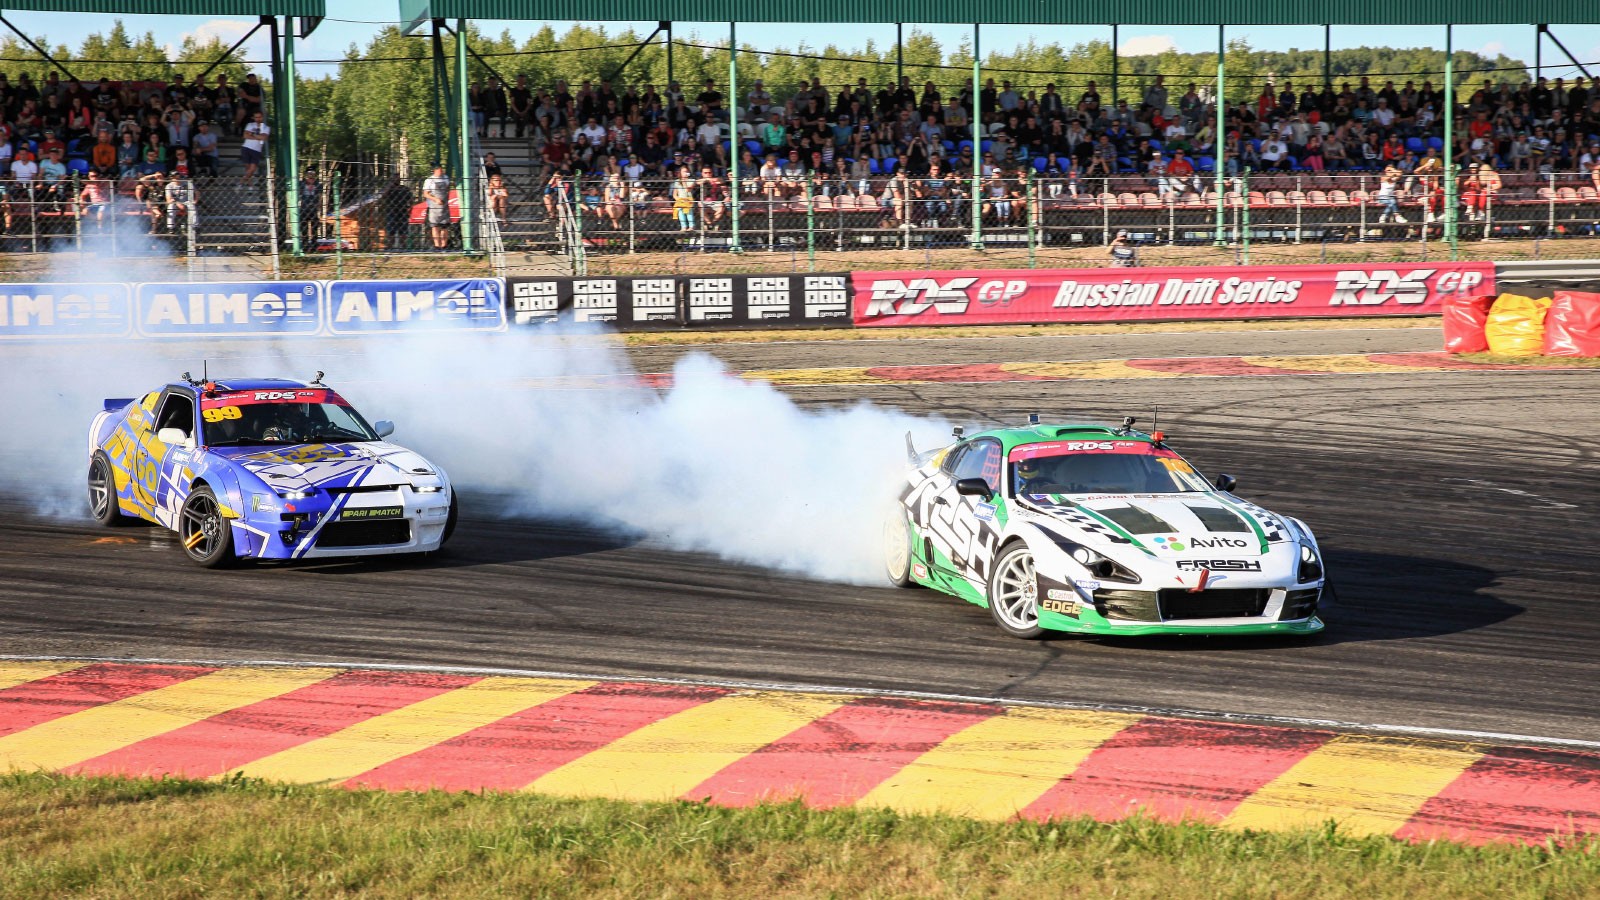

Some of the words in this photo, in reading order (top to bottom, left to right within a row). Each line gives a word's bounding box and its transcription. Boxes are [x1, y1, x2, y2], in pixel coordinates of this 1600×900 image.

[1052, 280, 1161, 308] Russian
[1160, 277, 1221, 305] Drift
[1217, 276, 1302, 304] Series
[1328, 269, 1437, 305] RDS
[1435, 271, 1483, 297] GP
[864, 277, 979, 316] RDS
[978, 280, 1027, 306] GP
[254, 391, 296, 401] RDS
[202, 405, 242, 423] 99
[1067, 442, 1115, 451] RDS
[346, 509, 367, 517] PARI
[373, 508, 401, 516] MATCH
[1190, 536, 1248, 549] Avito
[1042, 599, 1083, 615] EDGE
